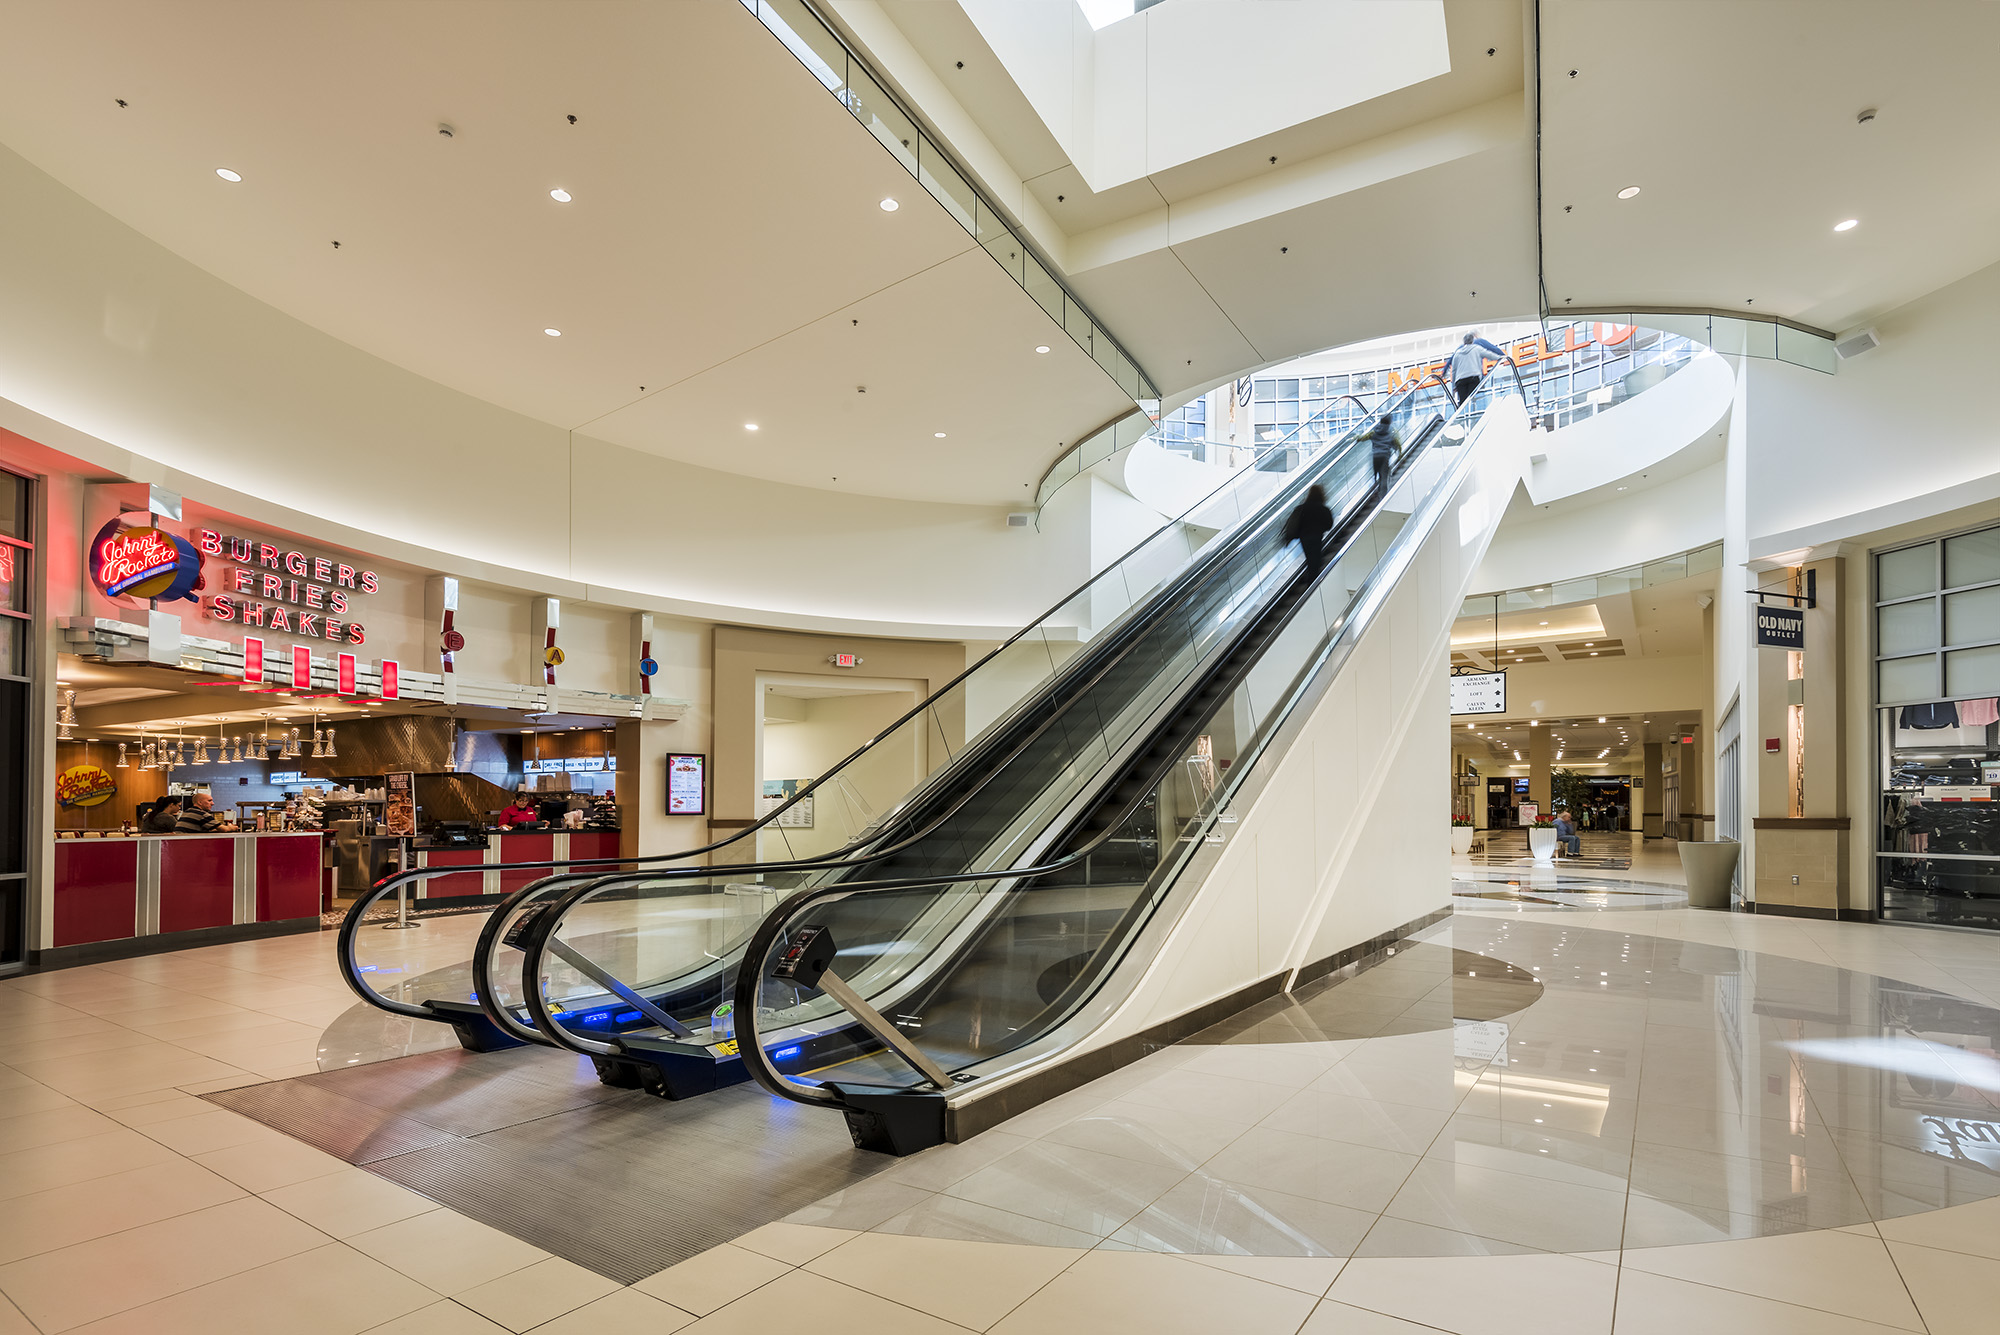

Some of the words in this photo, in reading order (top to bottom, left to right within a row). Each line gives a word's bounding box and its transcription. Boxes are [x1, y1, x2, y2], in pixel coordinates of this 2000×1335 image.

[1387, 328, 1591, 394] MEELL
[103, 530, 164, 582] Johnny
[110, 547, 175, 583] Rockets
[201, 528, 379, 594] BURGERS
[112, 584, 123, 592] THE
[122, 573, 143, 588] ORIGINAL
[144, 563, 174, 578] HAMBURGER
[235, 567, 349, 614] FRIES
[214, 594, 366, 645] SHAKES
[1758, 615, 1777, 629] OLD
[1777, 617, 1803, 632] NAVY
[1766, 630, 1796, 639] OUTLET
[550, 649, 562, 663] A
[644, 661, 655, 673] T
[840, 655, 852, 665] EXIT
[56, 769, 108, 800] Johnny
[63, 777, 117, 800] Rockets
